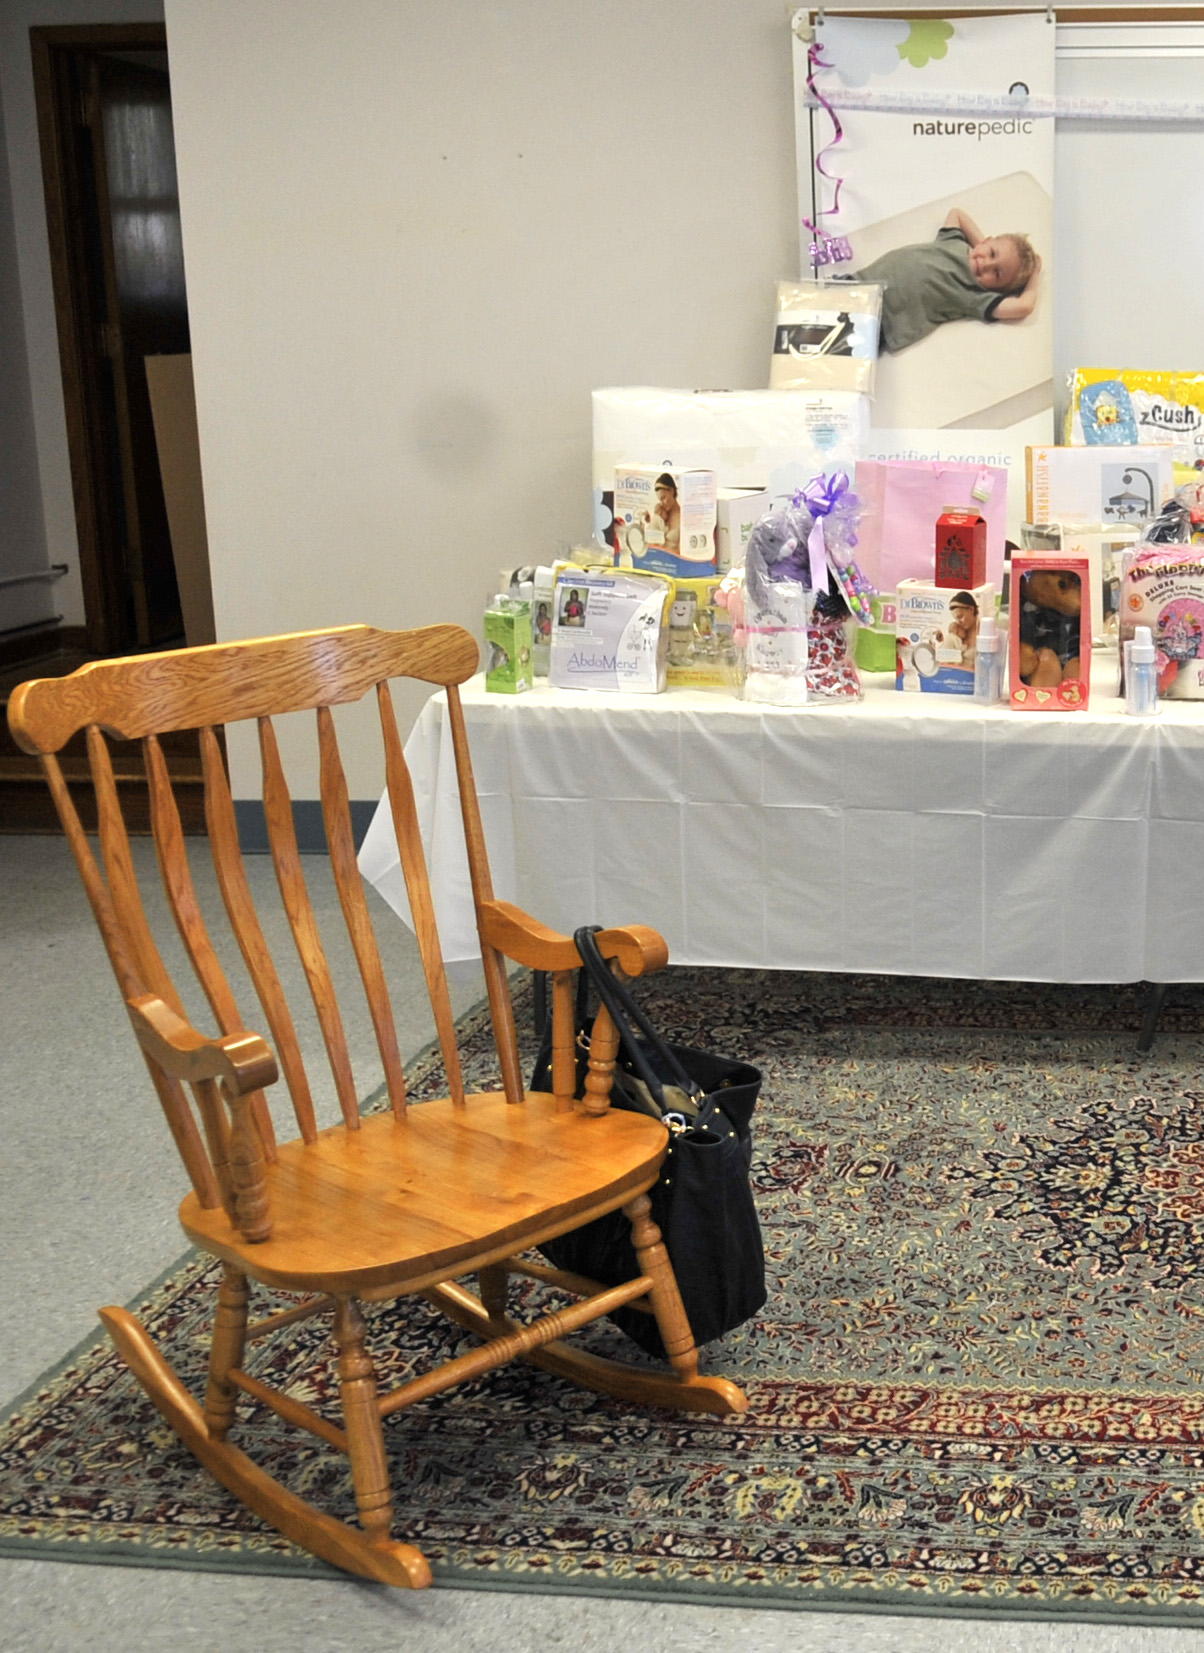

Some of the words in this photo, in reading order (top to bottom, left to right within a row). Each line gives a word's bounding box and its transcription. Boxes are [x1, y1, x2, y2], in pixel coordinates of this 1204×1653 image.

[913, 119, 1033, 141] naturepedic
[1139, 404, 1195, 424] zCush
[567, 652, 638, 671] AbdoMend
